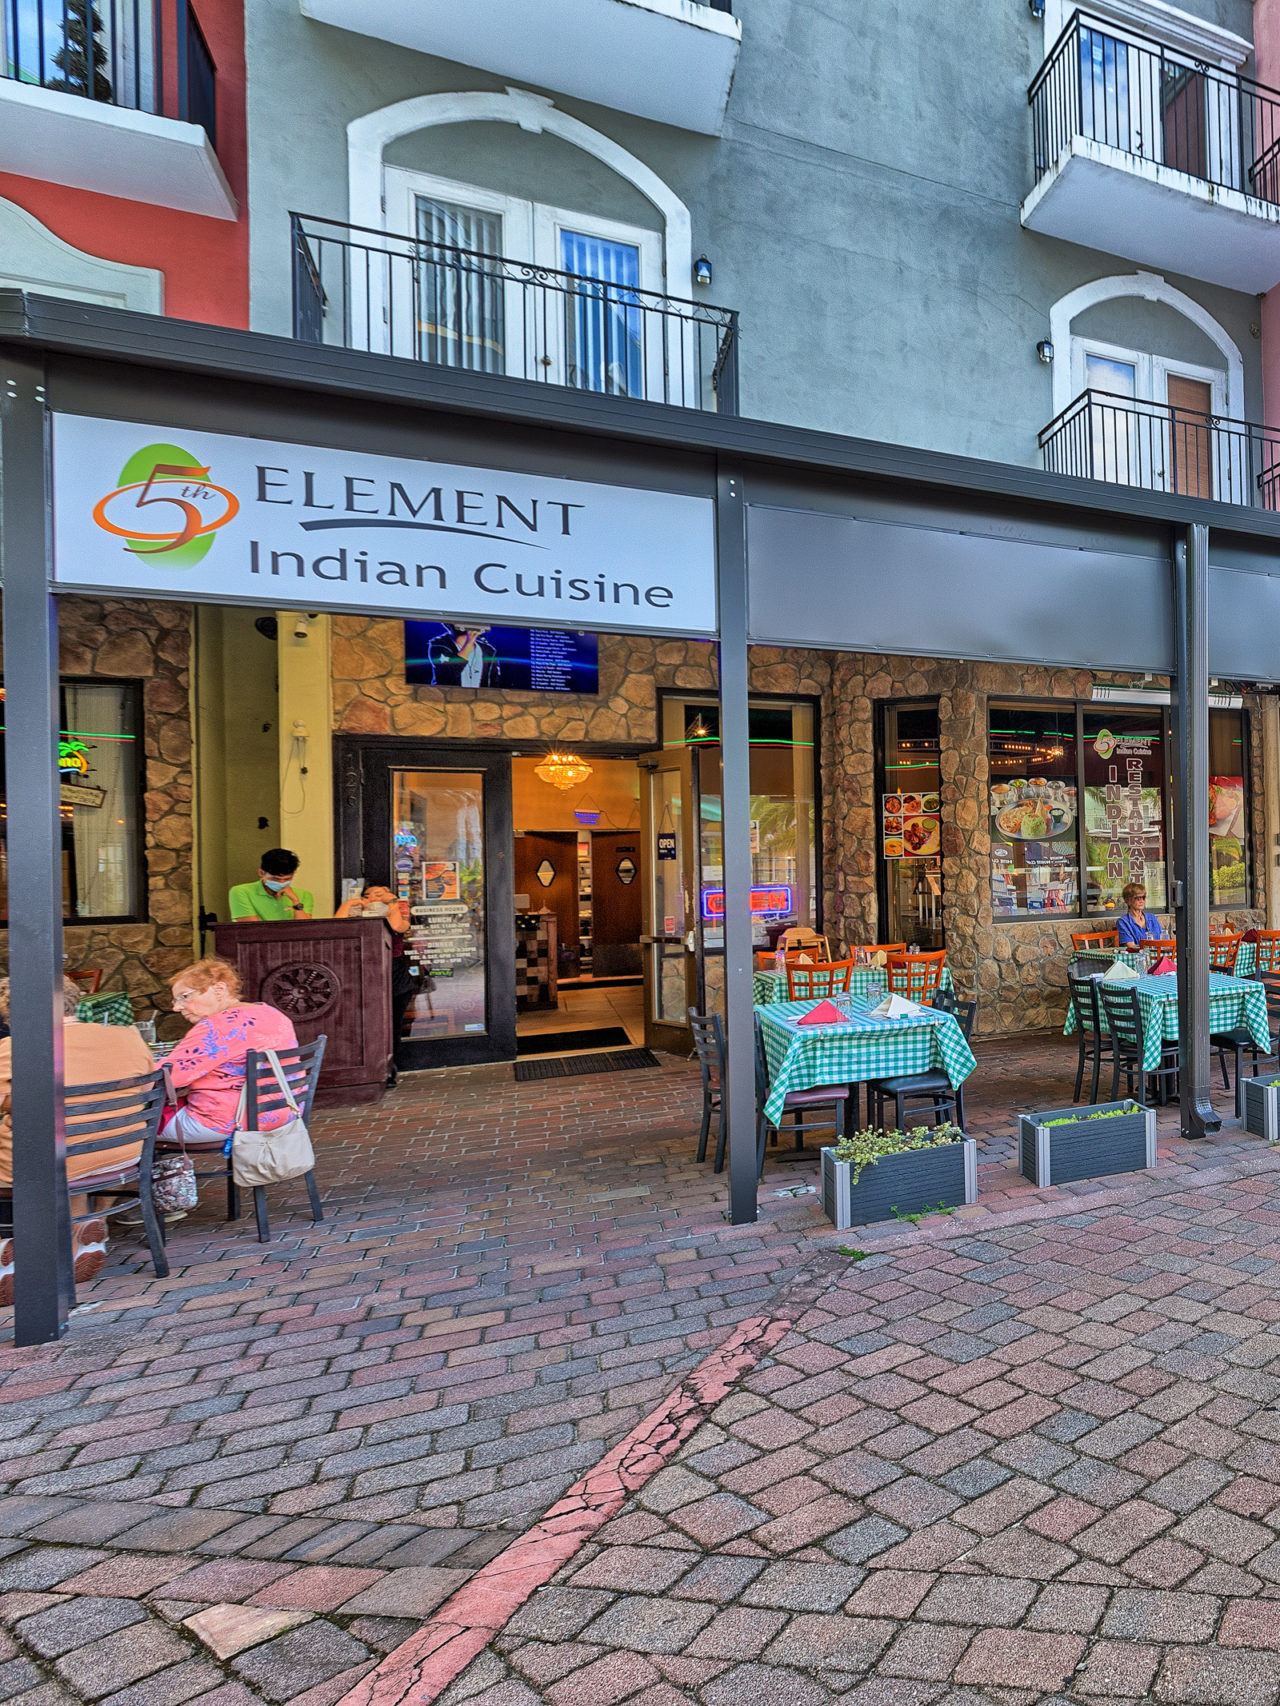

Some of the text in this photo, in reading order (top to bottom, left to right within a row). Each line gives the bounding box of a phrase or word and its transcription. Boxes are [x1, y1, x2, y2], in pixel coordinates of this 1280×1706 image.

[123, 464, 585, 554] 5th ELEMENT
[250, 540, 674, 608] Indian Cuisine
[659, 838, 675, 849] OPEN
[1106, 765, 1123, 879] INDIAN
[1127, 758, 1145, 884] RESTAURANT
[707, 891, 788, 913] OEN
